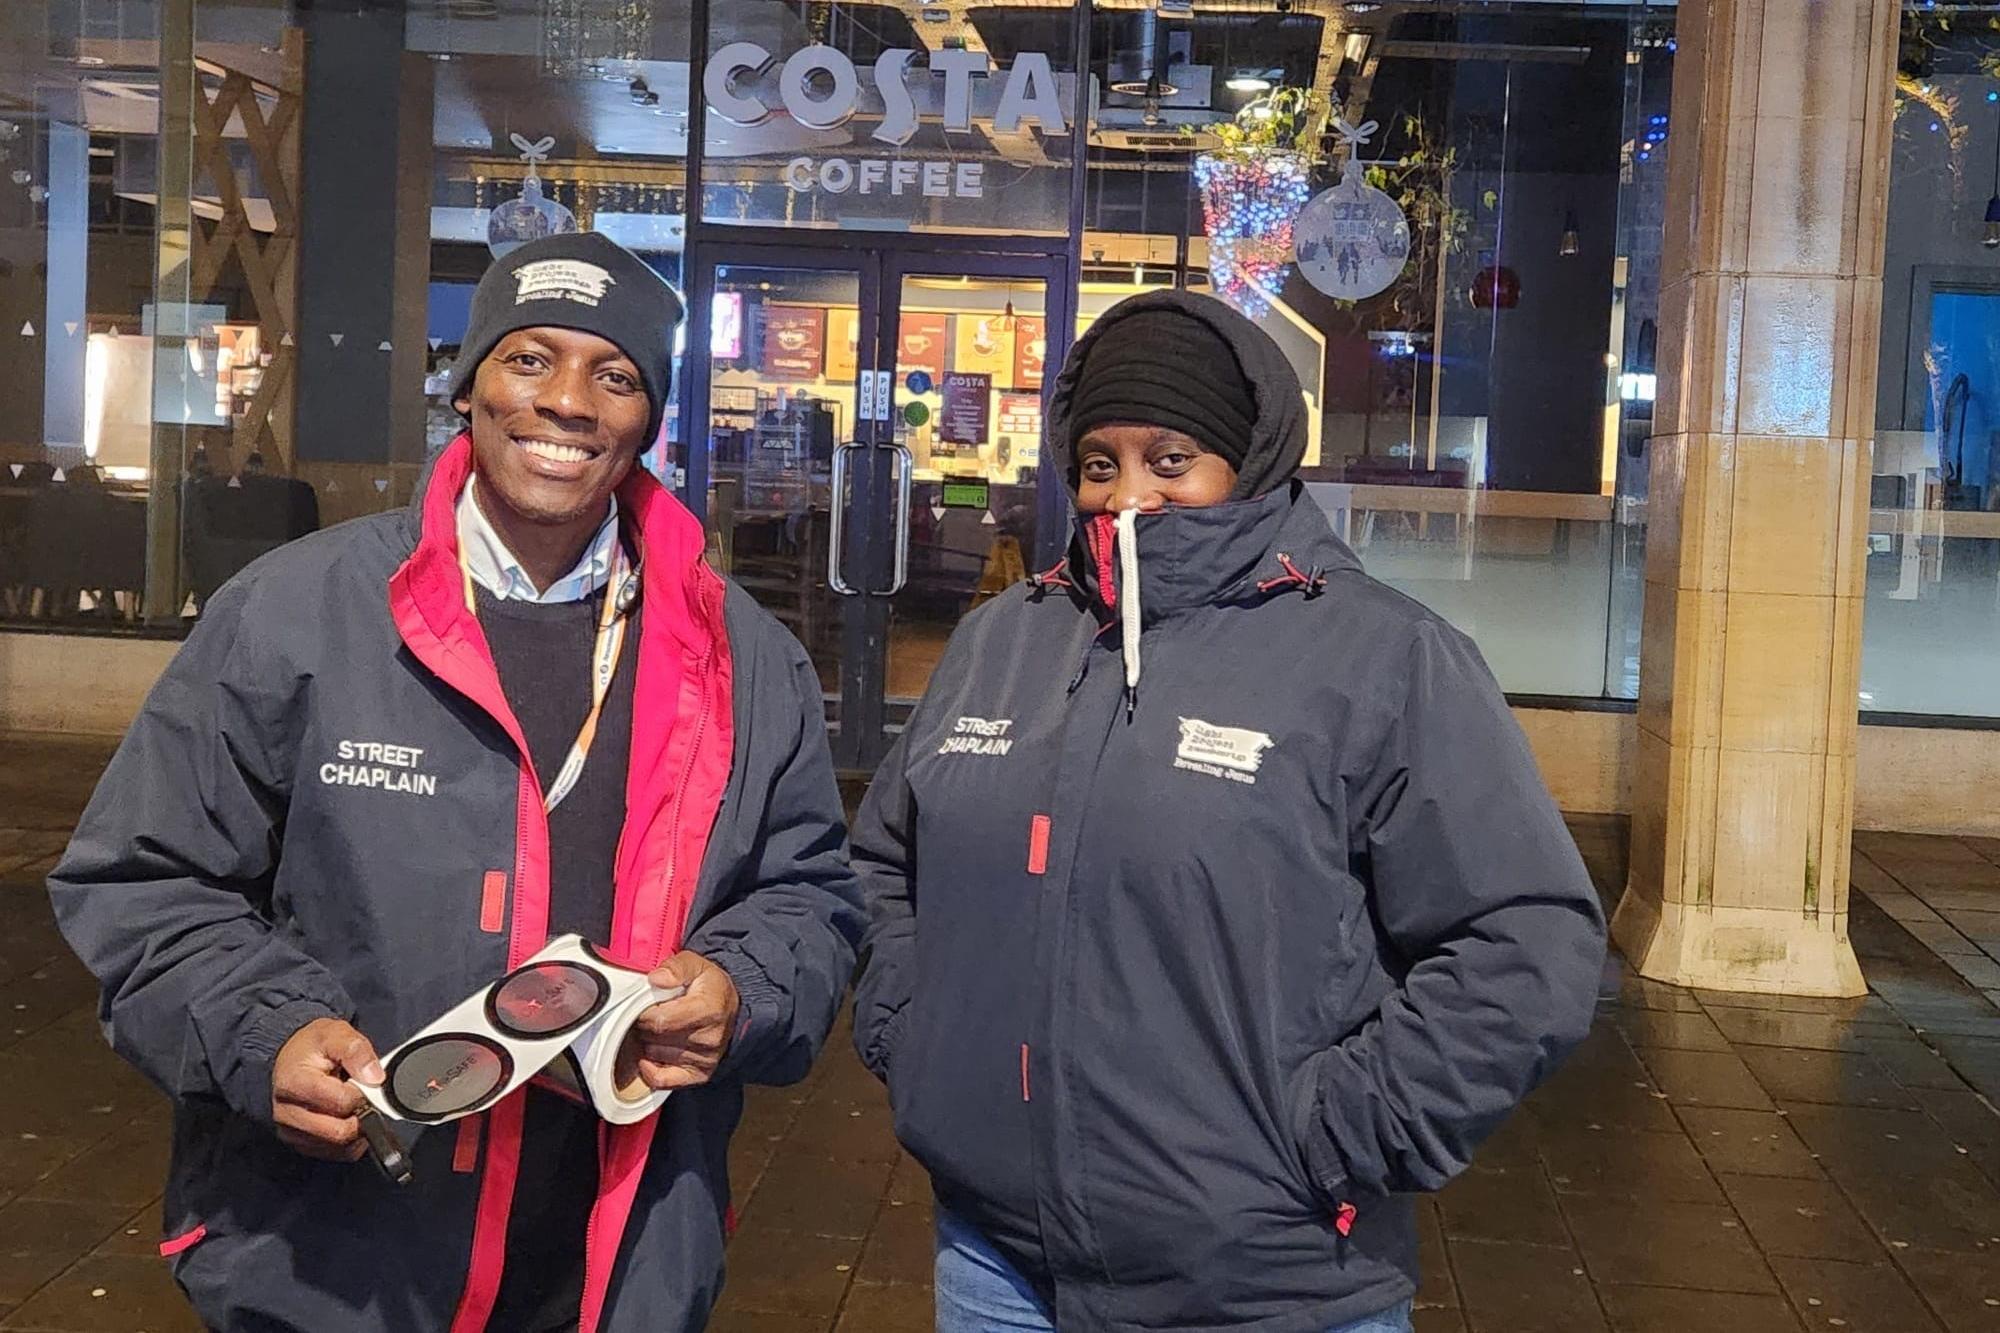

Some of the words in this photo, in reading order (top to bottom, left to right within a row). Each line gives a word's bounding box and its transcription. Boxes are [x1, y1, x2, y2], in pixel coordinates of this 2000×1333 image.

[703, 41, 1070, 146] COSTA
[786, 156, 984, 198] COFFEE
[863, 374, 872, 414] PUSH
[878, 376, 888, 415] PUSH
[949, 376, 986, 388] COSTA
[954, 716, 1013, 736] STREET
[337, 740, 424, 768] STREET
[319, 762, 437, 796] CHAPLAIN
